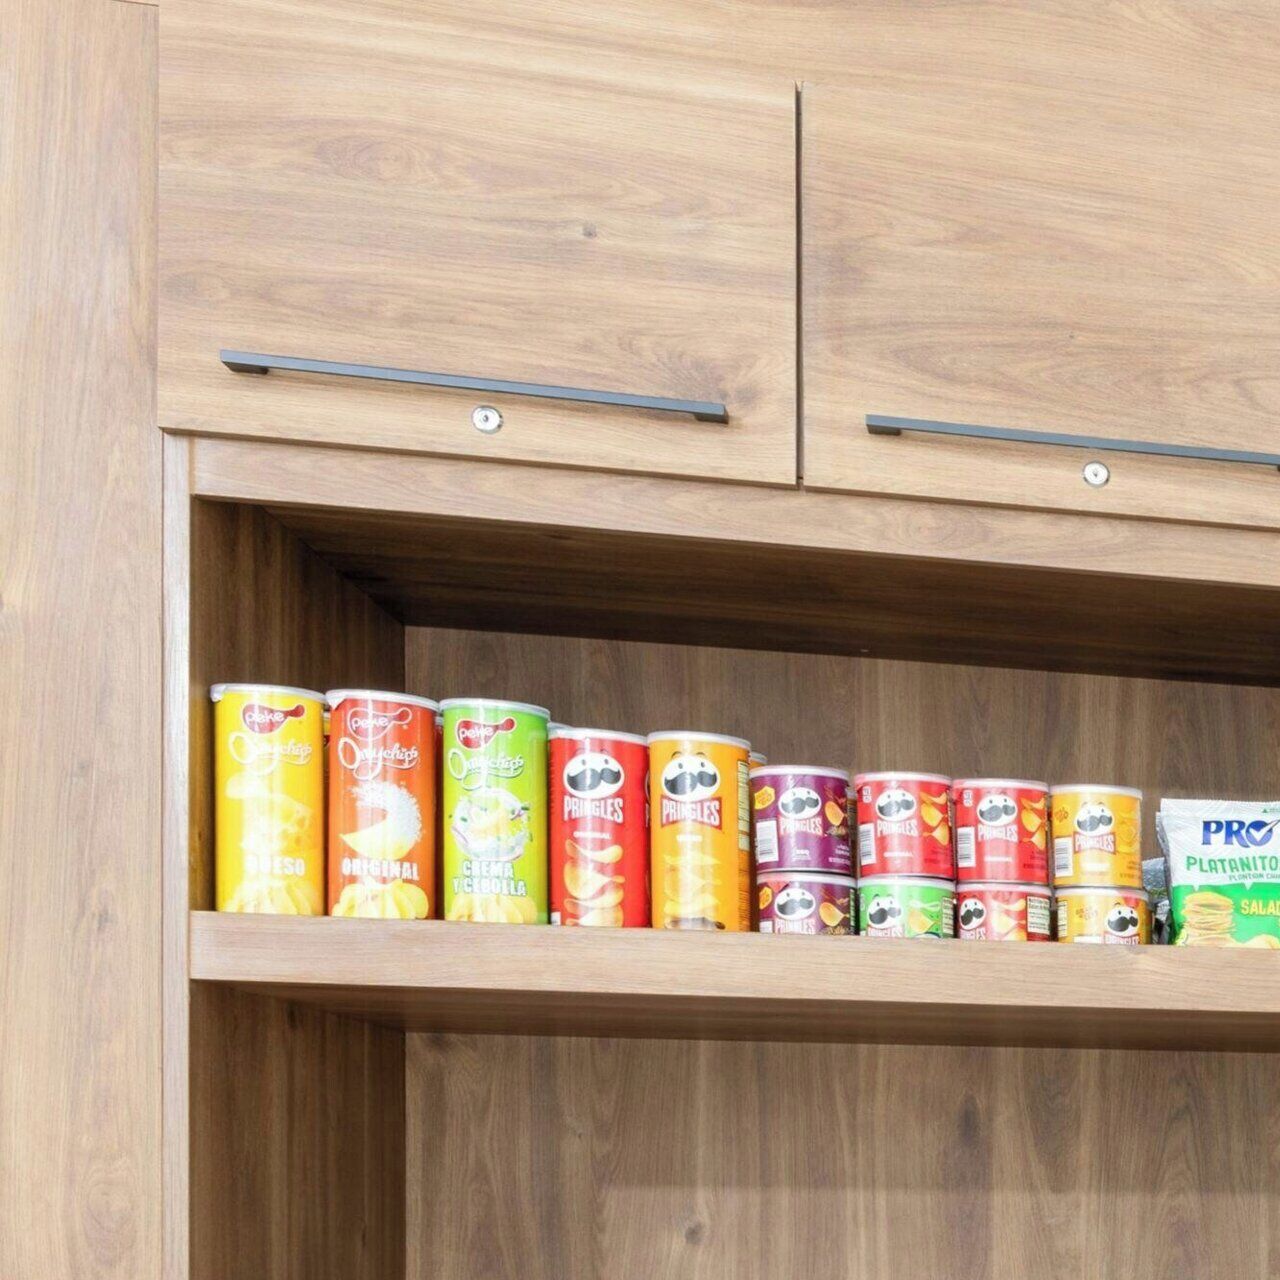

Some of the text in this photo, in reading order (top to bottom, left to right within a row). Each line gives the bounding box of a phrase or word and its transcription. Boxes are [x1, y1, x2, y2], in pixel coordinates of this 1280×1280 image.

[564, 796, 623, 823] PRINGLES
[662, 798, 720, 825] PRINGLES
[780, 818, 822, 836] PRINGLES
[877, 820, 918, 836] PRINGLES
[978, 824, 1018, 842] PRINGLES
[1202, 820, 1280, 848] PRO
[1075, 834, 1114, 852] PRINGLES
[342, 858, 419, 880] ORIGINAL
[463, 861, 514, 877] CREMA
[464, 879, 526, 896] CEBOLLA
[774, 919, 816, 934] PRINGLES
